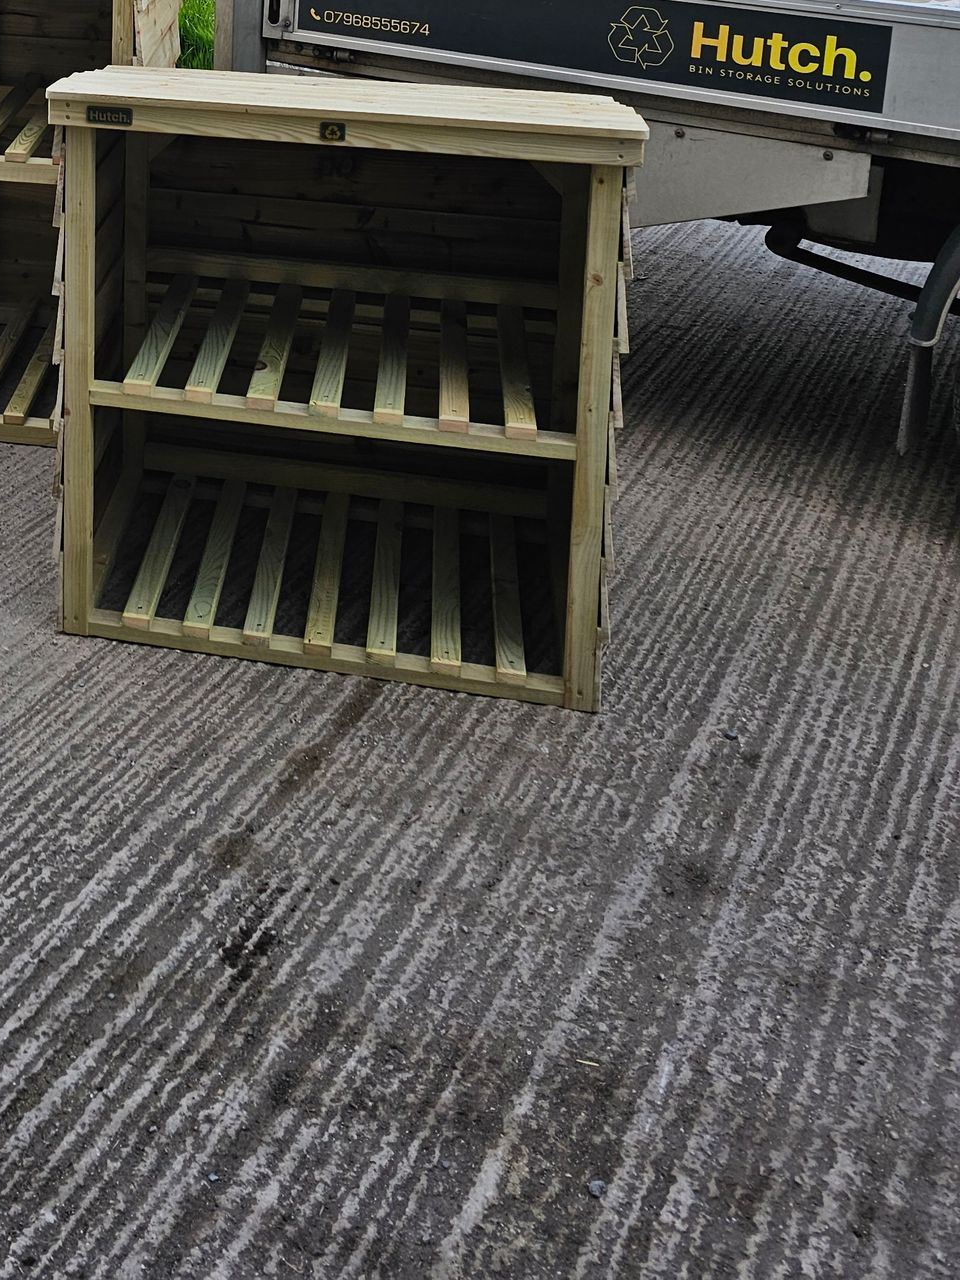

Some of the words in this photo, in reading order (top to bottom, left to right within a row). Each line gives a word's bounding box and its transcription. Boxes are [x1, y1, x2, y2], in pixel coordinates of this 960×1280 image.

[323, 10, 430, 36] 07968555674
[690, 21, 872, 82] Hutch.
[689, 64, 713, 75] BIN
[719, 68, 781, 85] STORAGE
[787, 78, 870, 97] SOLUTIONS
[89, 110, 130, 123] Hutch.
